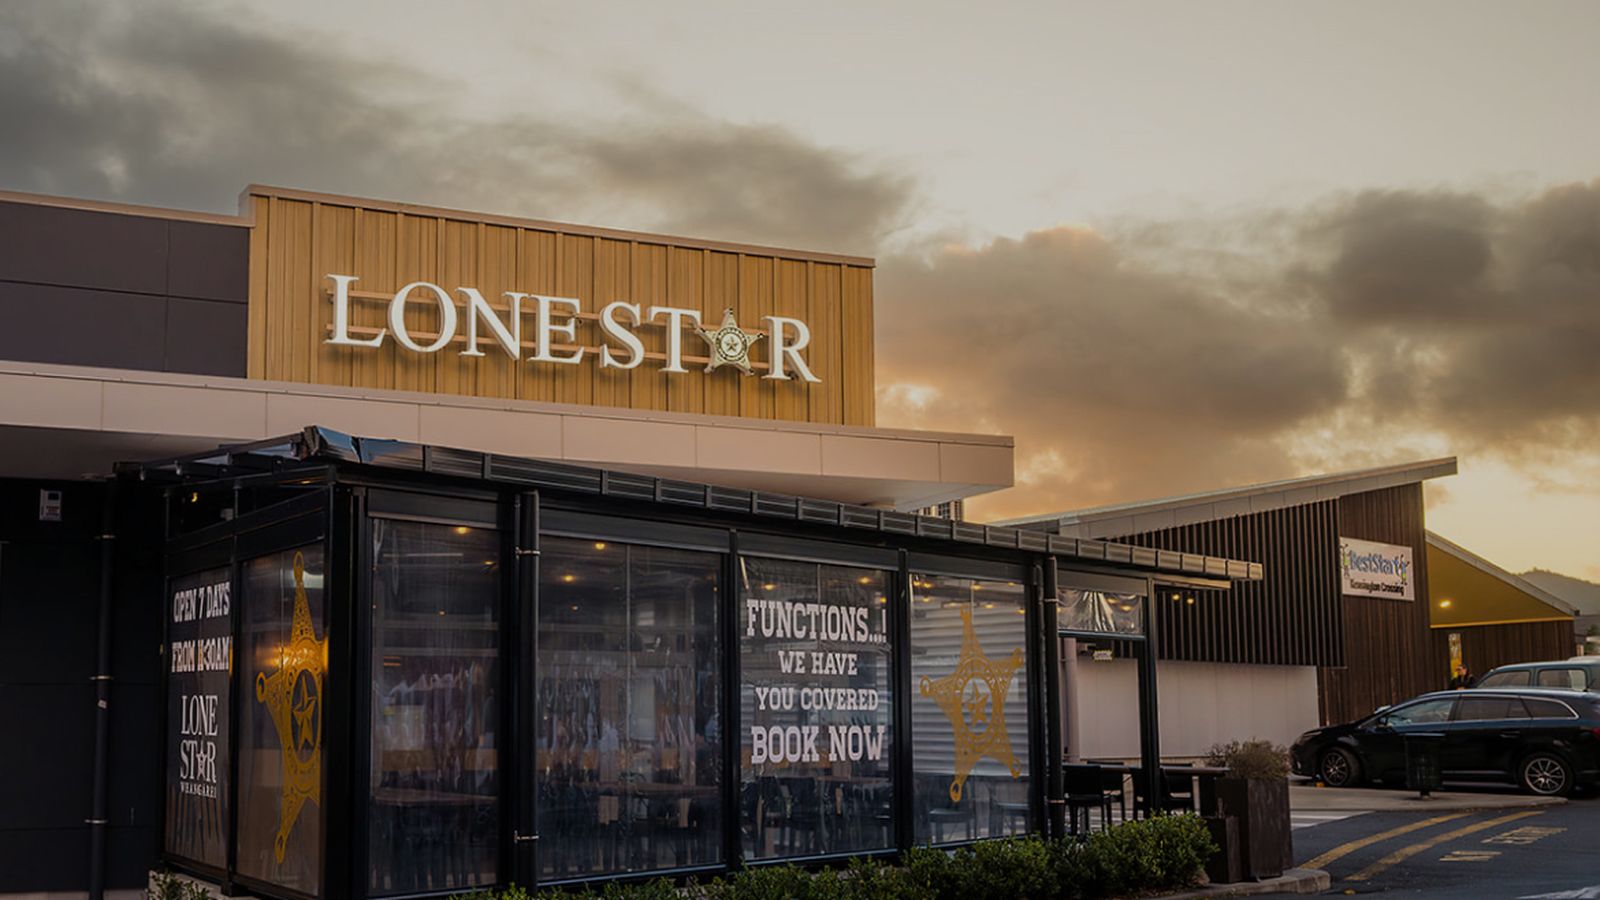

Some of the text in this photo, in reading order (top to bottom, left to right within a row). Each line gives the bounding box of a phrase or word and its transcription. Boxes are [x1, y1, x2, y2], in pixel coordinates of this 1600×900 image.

[323, 273, 585, 365] LONE
[174, 581, 230, 623] OPEN 7 DAYS
[172, 640, 195, 673] FROM
[778, 650, 858, 676] WE HAVE
[181, 695, 218, 736] LONE
[755, 687, 879, 711] YOU COVERED
[751, 725, 885, 764] BOOK NOW
